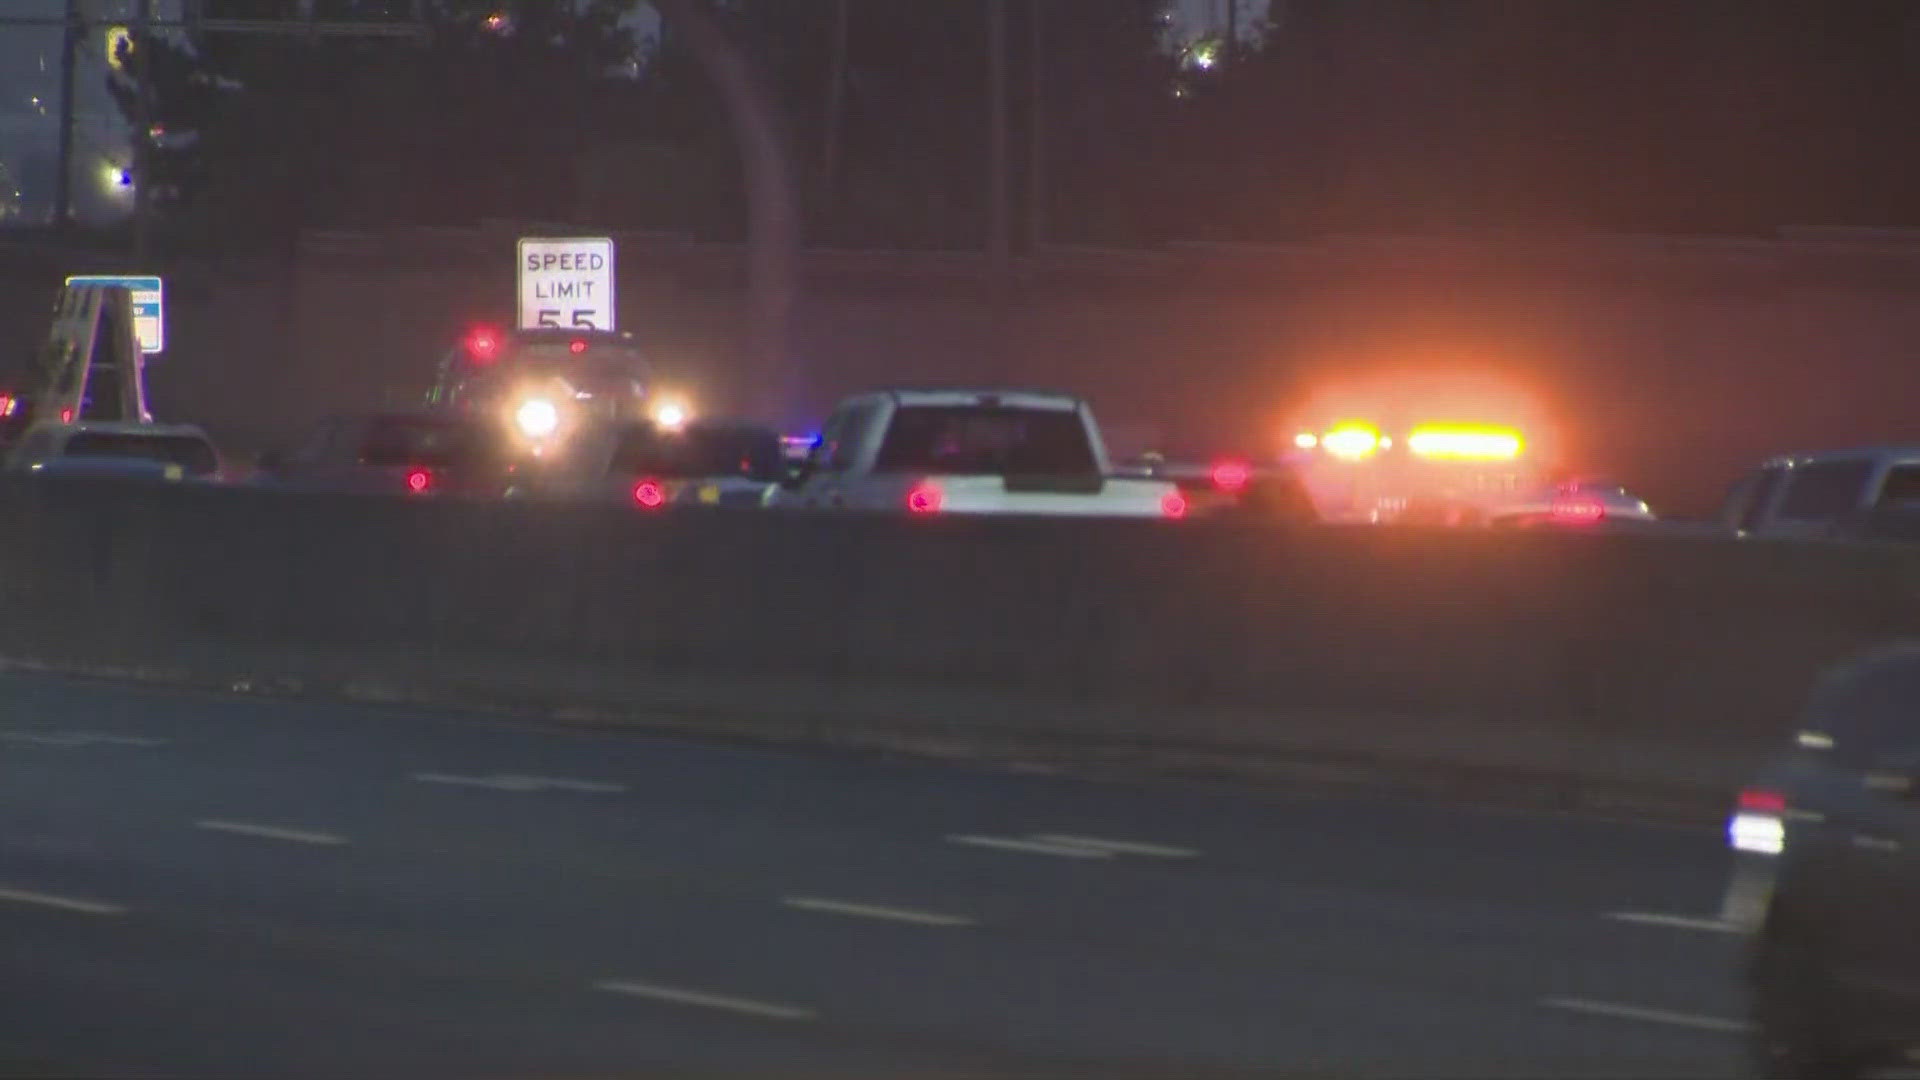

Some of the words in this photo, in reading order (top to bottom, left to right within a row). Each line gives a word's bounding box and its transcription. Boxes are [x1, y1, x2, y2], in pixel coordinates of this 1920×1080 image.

[527, 253, 604, 271] SPEED
[535, 281, 595, 298] LIMIT
[538, 309, 597, 331] 55
